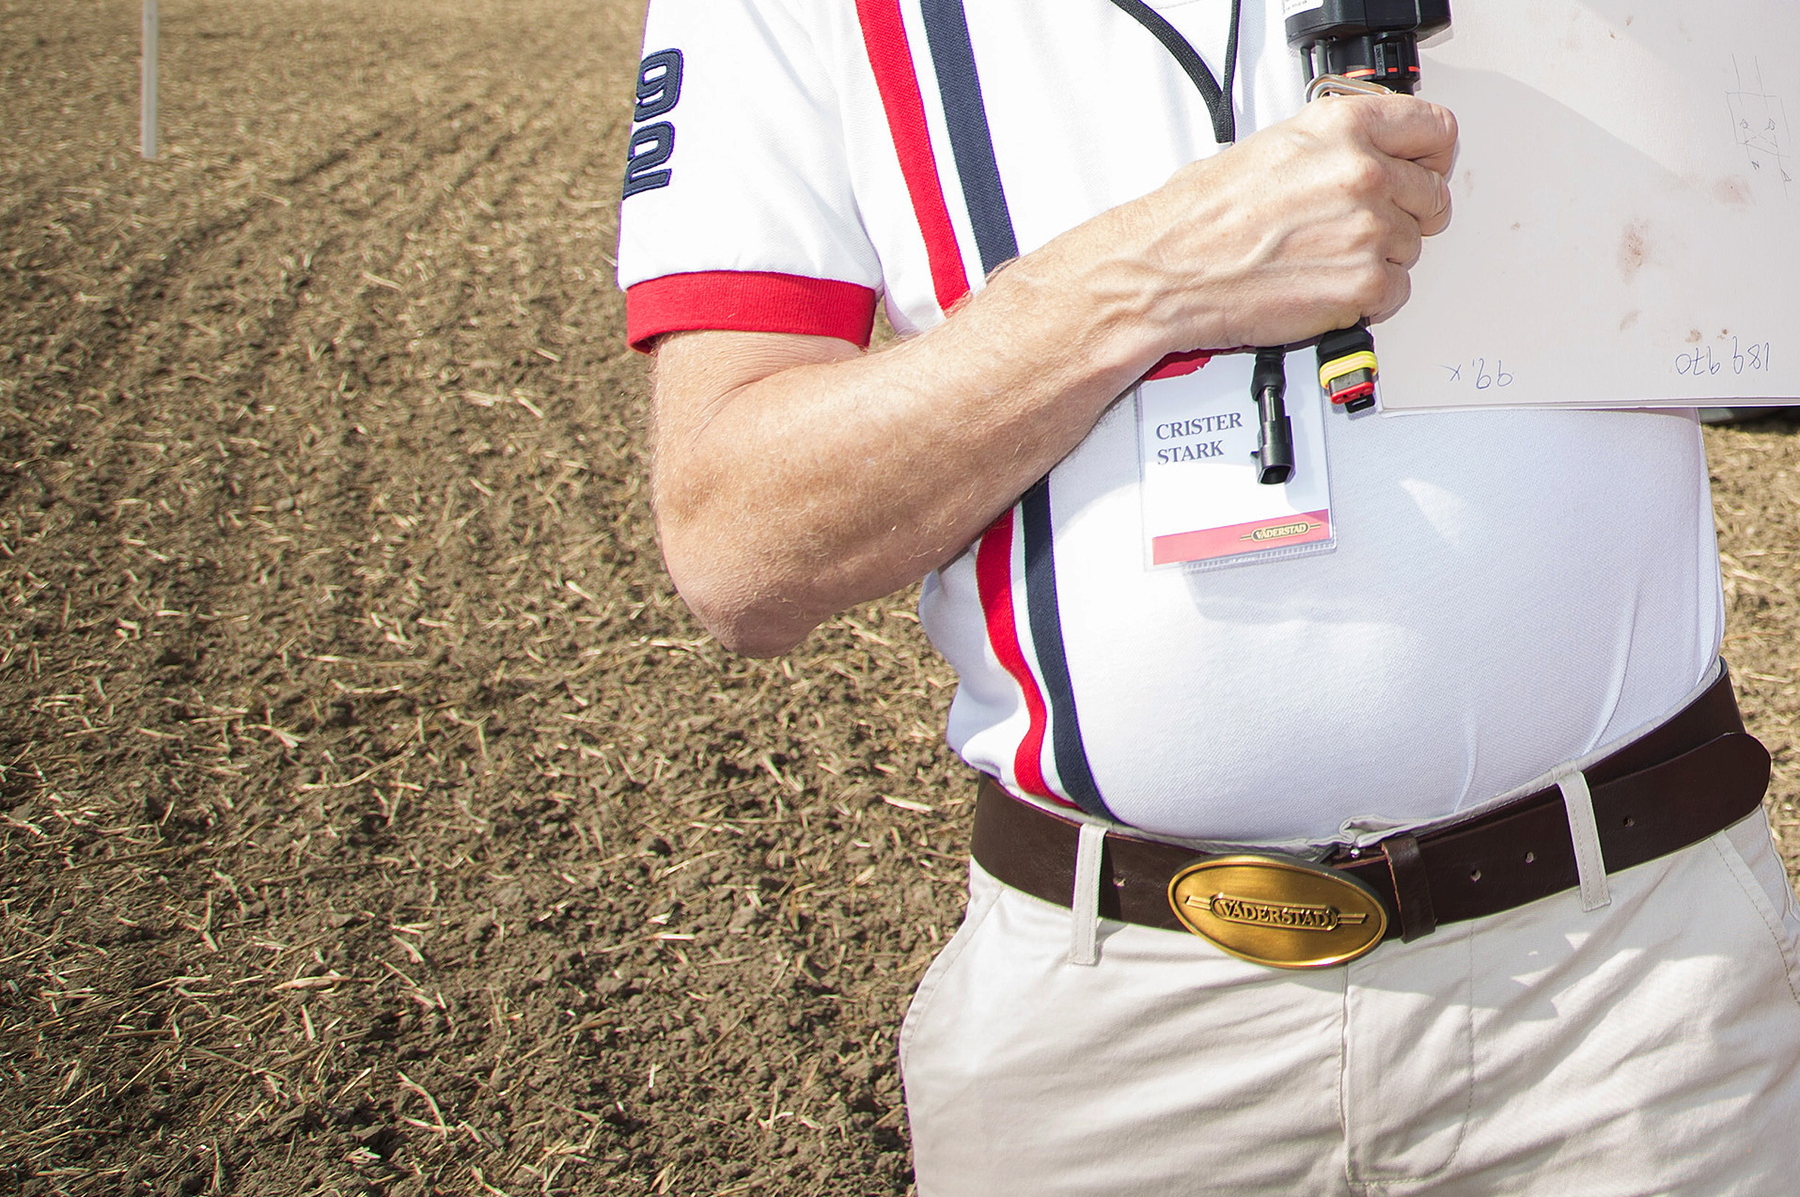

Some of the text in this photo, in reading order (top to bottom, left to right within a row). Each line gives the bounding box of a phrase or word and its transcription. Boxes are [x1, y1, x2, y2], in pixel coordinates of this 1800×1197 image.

[1155, 412, 1243, 441] CRISTER
[1156, 439, 1225, 466] STARK
[1254, 522, 1308, 542] VÄDERSTAD
[1218, 900, 1331, 928] VÄDERSTAD
